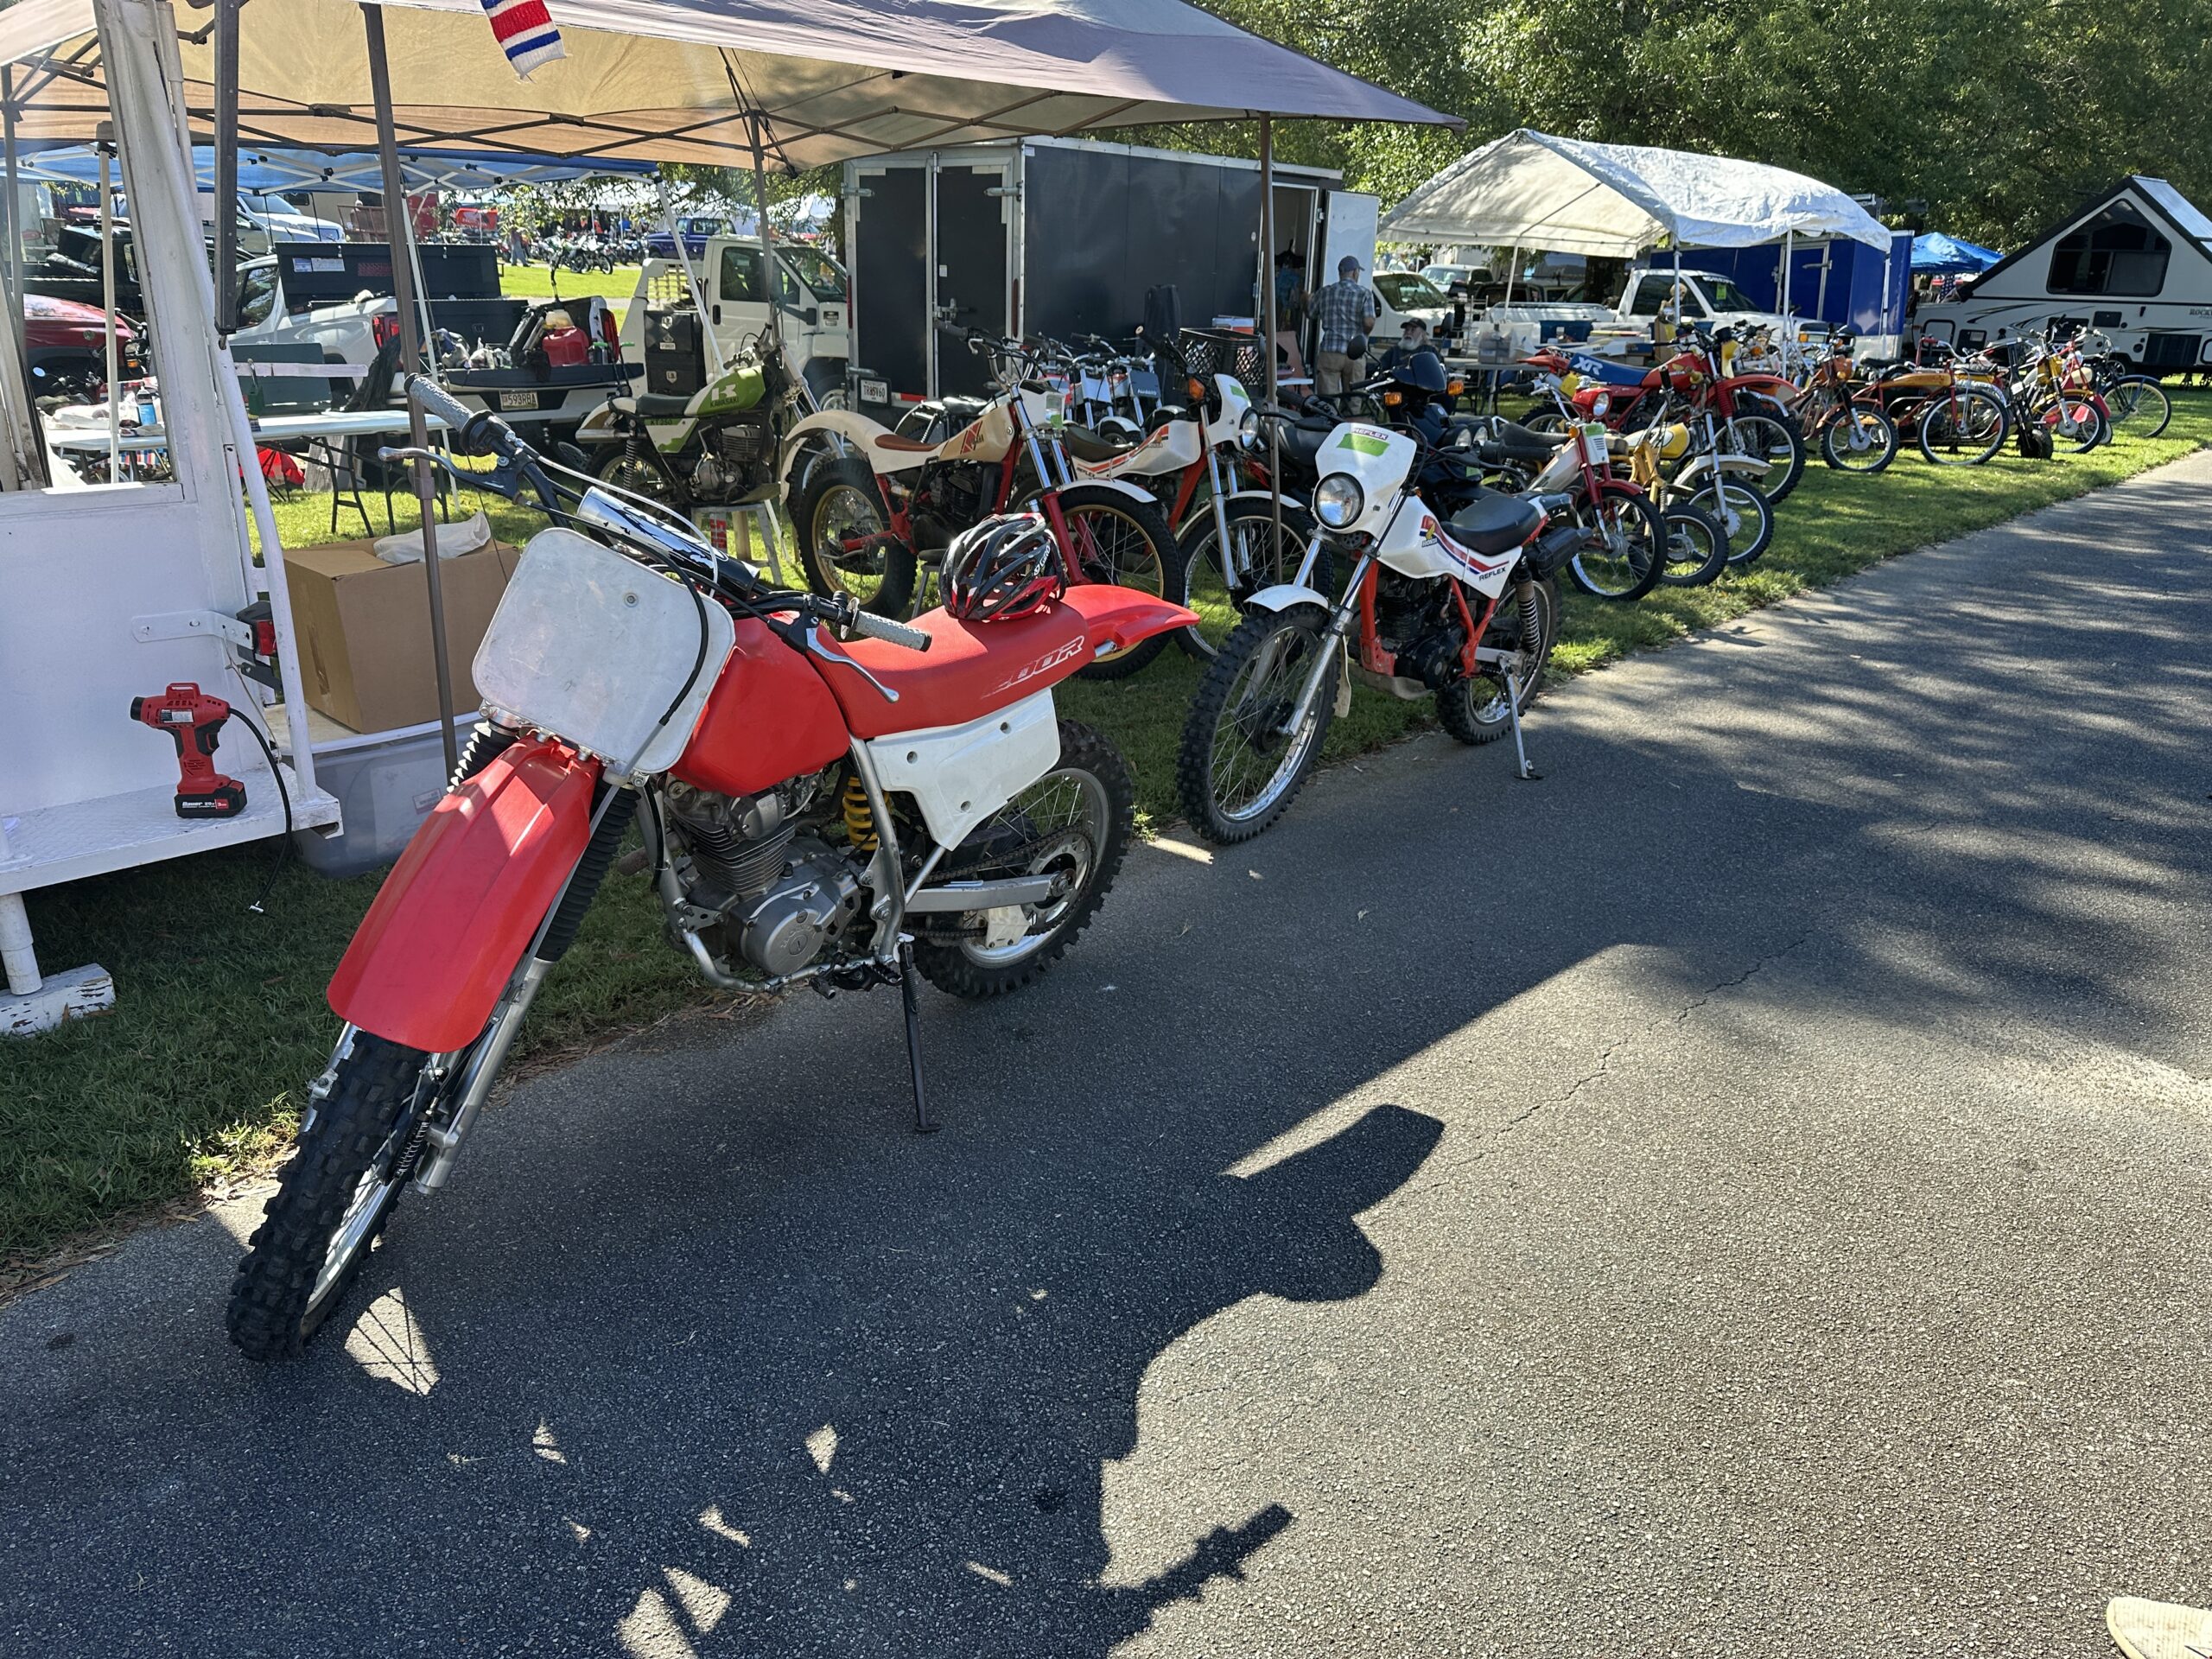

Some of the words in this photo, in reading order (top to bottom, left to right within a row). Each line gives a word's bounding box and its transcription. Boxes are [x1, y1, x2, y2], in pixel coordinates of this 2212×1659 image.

[1573, 356, 1604, 376] XR
[709, 397, 740, 409] KAWASAKI
[1351, 427, 1389, 441] REFLEX
[1076, 467, 1096, 478] REFLEX
[1421, 537, 1438, 548] HONDA
[1478, 566, 1506, 582] REFLEX
